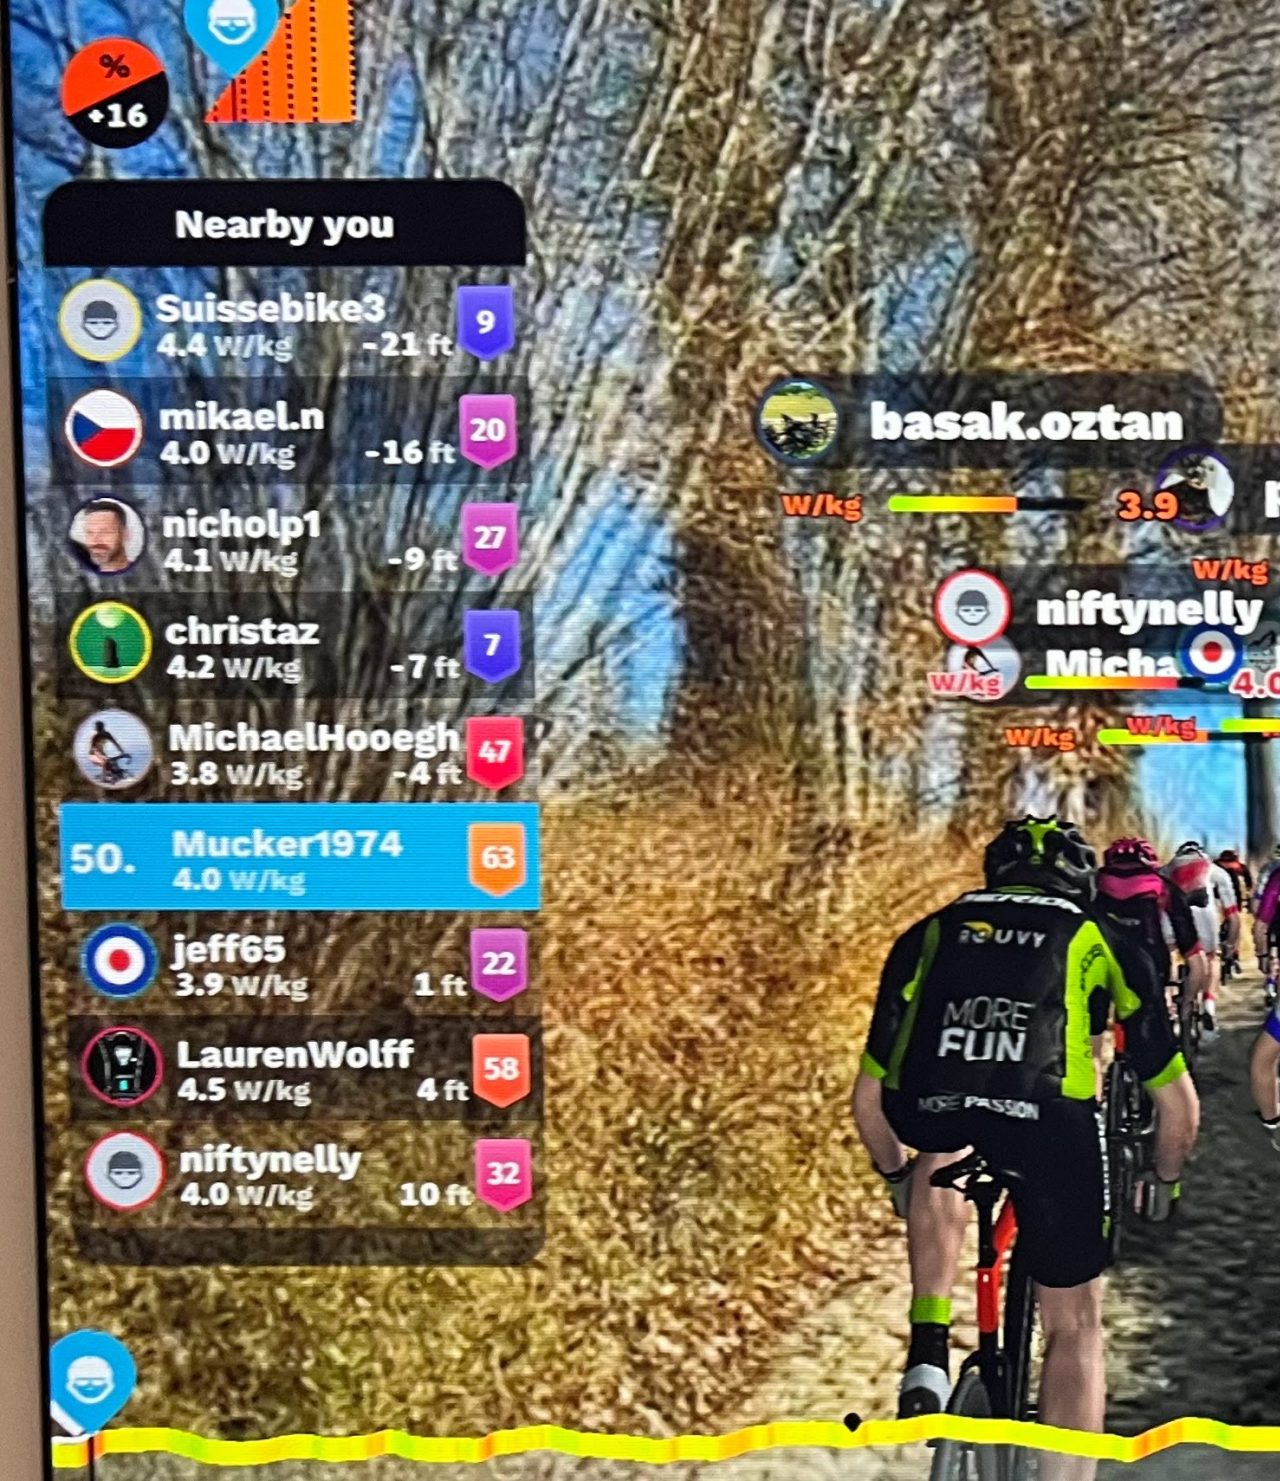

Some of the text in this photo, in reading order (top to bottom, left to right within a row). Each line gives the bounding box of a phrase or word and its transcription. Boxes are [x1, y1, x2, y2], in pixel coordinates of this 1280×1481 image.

[99, 54, 131, 78] %
[88, 103, 149, 129] +16
[175, 210, 395, 246] Nearby you
[155, 293, 387, 325] Suissebike3
[475, 309, 497, 335] 9
[156, 332, 294, 363] 4.4 W/kg
[363, 332, 455, 358] -21 ft
[160, 400, 326, 433] mikael.n
[469, 417, 507, 443] 20
[870, 400, 1184, 442] basak.oztan
[160, 440, 296, 471] 4.0 W/kg
[365, 439, 457, 466] -16 ft
[782, 493, 863, 523] W/kg
[1117, 490, 1180, 522] 3.9
[162, 508, 322, 546] nicholp1
[473, 525, 508, 551] 27
[164, 548, 299, 578] 4.1 W/kg
[388, 548, 459, 572] -9 ft
[1193, 557, 1270, 585] W/kg
[1036, 589, 1265, 636] niftynelly
[165, 615, 321, 647] christaz
[484, 633, 501, 657] 7
[166, 655, 302, 684] 4.2 W/kg
[390, 654, 460, 680] -7 ft
[927, 671, 1004, 700] W/kg
[168, 721, 461, 764] MichaelHooegh
[1004, 727, 1077, 753] W/kg
[1126, 715, 1200, 742] W/kg
[478, 738, 512, 763] 47
[170, 761, 305, 791] 3.8 W/kg
[393, 761, 464, 786] -4 ft
[173, 829, 405, 859] Mucker1974
[482, 844, 516, 870] 63
[70, 843, 137, 875] 50.
[173, 868, 306, 897] 4.0 W/kg
[170, 932, 287, 972] jeff65
[482, 951, 518, 976] 22
[175, 973, 309, 1002] 3.9 W/kg
[414, 972, 468, 998] 1 ft
[942, 994, 1036, 1031] MORE
[178, 1039, 415, 1071] LaurenWolff
[937, 1027, 1028, 1063] FUN
[483, 1056, 520, 1082] 58
[177, 1077, 312, 1107] 4.5 W/kg
[416, 1077, 471, 1102] 4 ft
[180, 1143, 363, 1182] niftynelly
[486, 1161, 521, 1187] 32
[180, 1182, 315, 1212] 4.0 W/kg
[399, 1182, 473, 1207] 10 ft
